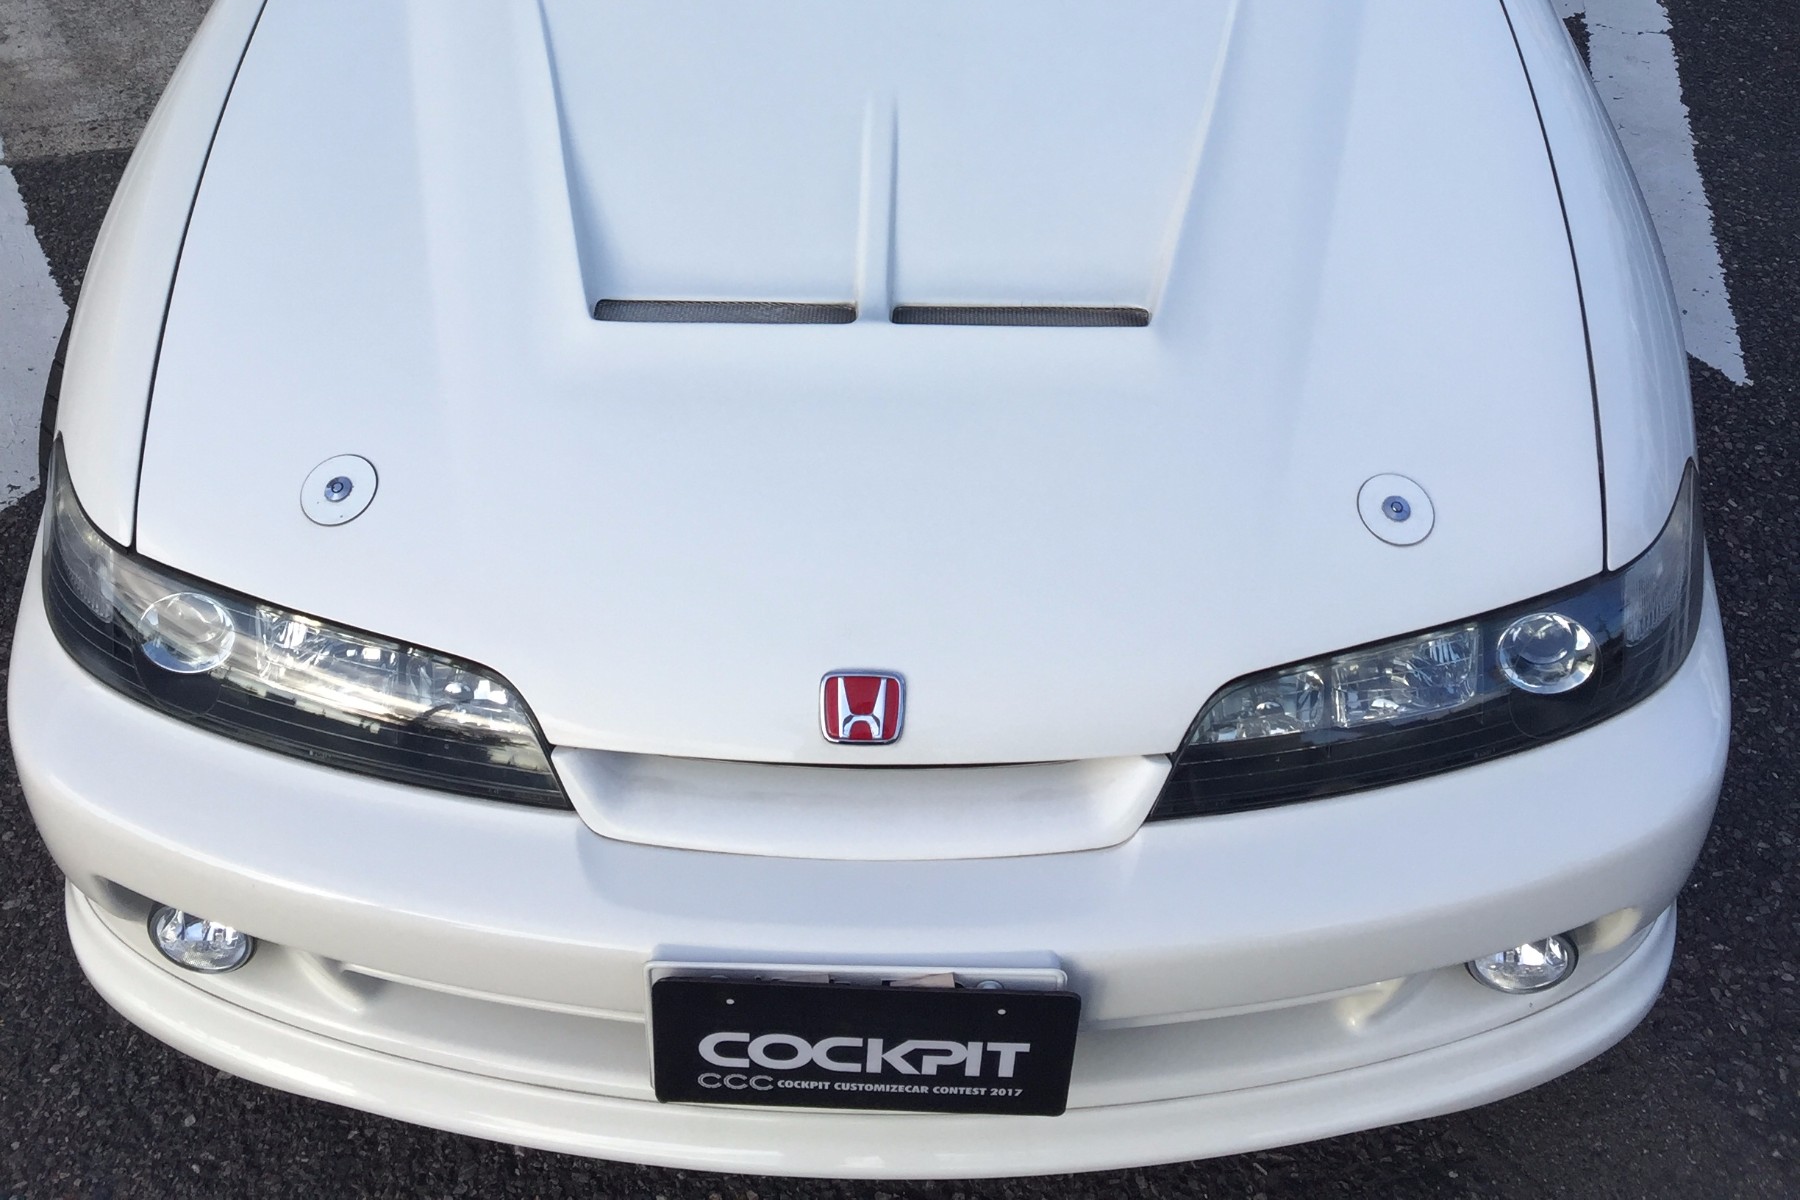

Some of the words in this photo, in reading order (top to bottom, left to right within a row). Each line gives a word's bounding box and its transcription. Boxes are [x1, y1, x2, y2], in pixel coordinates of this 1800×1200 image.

[698, 1031, 1031, 1078] COCKPIT
[777, 1079, 831, 1091] COCKPIT
[833, 1081, 929, 1094] CUSTOMIZECAR
[932, 1085, 987, 1096] CONTEST
[989, 1087, 1023, 1097] 2017
